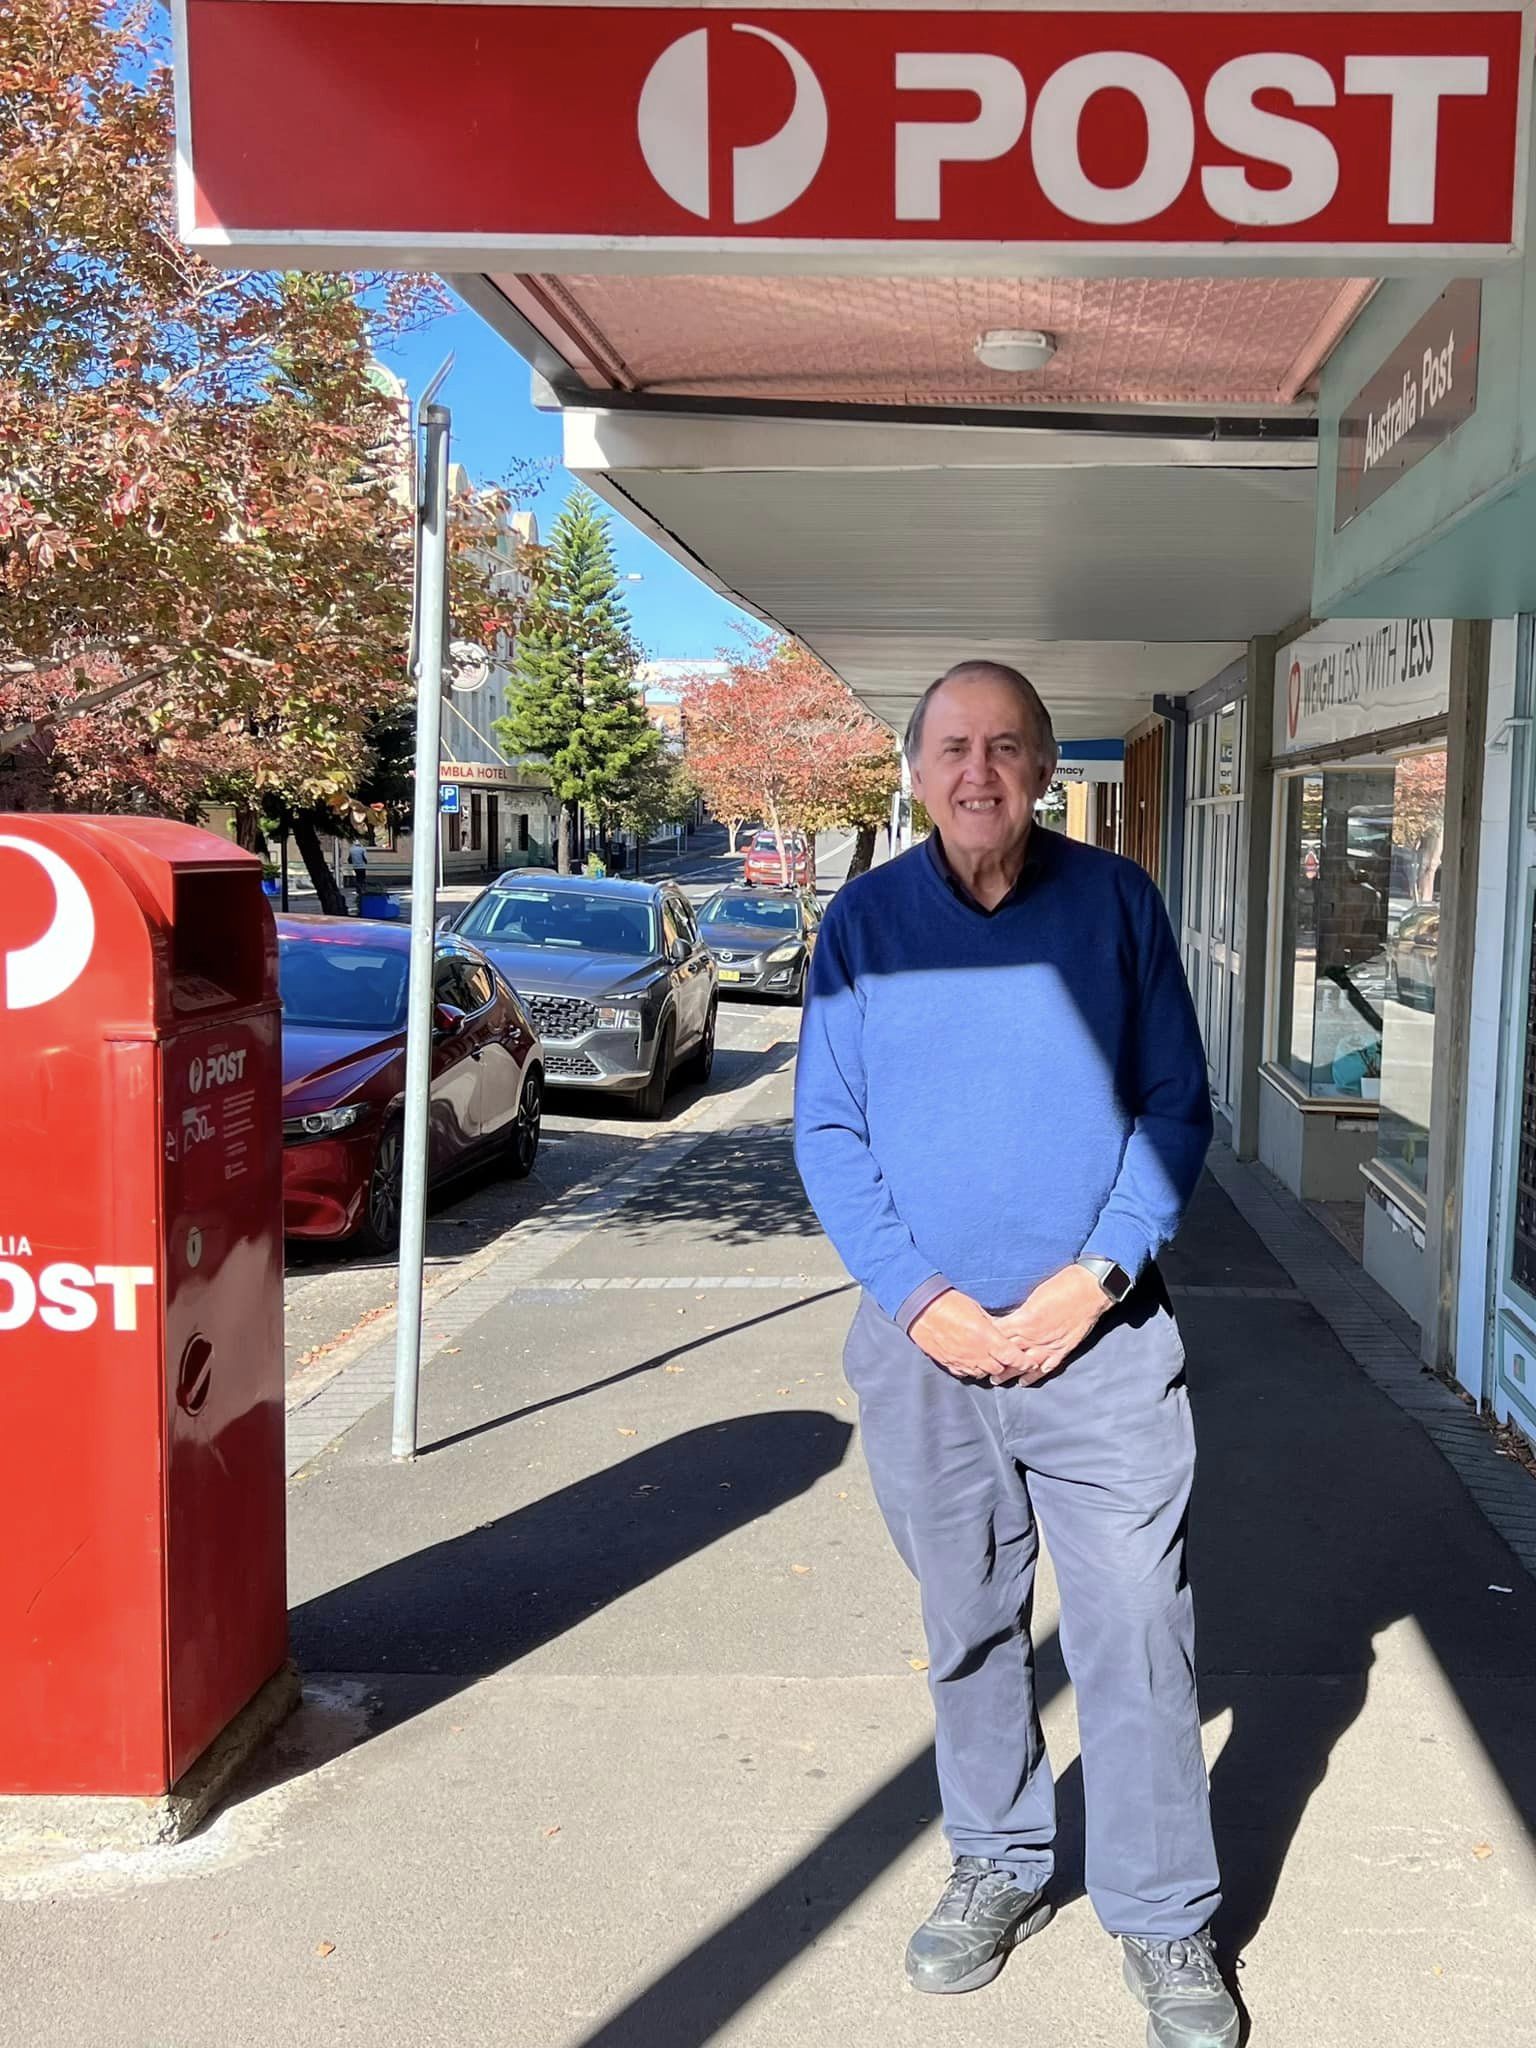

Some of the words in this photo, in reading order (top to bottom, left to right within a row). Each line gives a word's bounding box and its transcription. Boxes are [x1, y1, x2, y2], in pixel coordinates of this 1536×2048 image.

[894, 50, 1489, 226] POST
[1363, 369, 1417, 473] Australia
[1420, 328, 1455, 418] Post
[1303, 653, 1336, 718] WEIGH
[1338, 641, 1361, 704] LESS
[1365, 621, 1398, 693] WITH
[1401, 618, 1434, 683] JESS
[440, 766, 474, 778] MBLA
[477, 768, 508, 780] HOTEL
[206, 1049, 247, 1089] POST
[0, 1261, 154, 1332] OST
